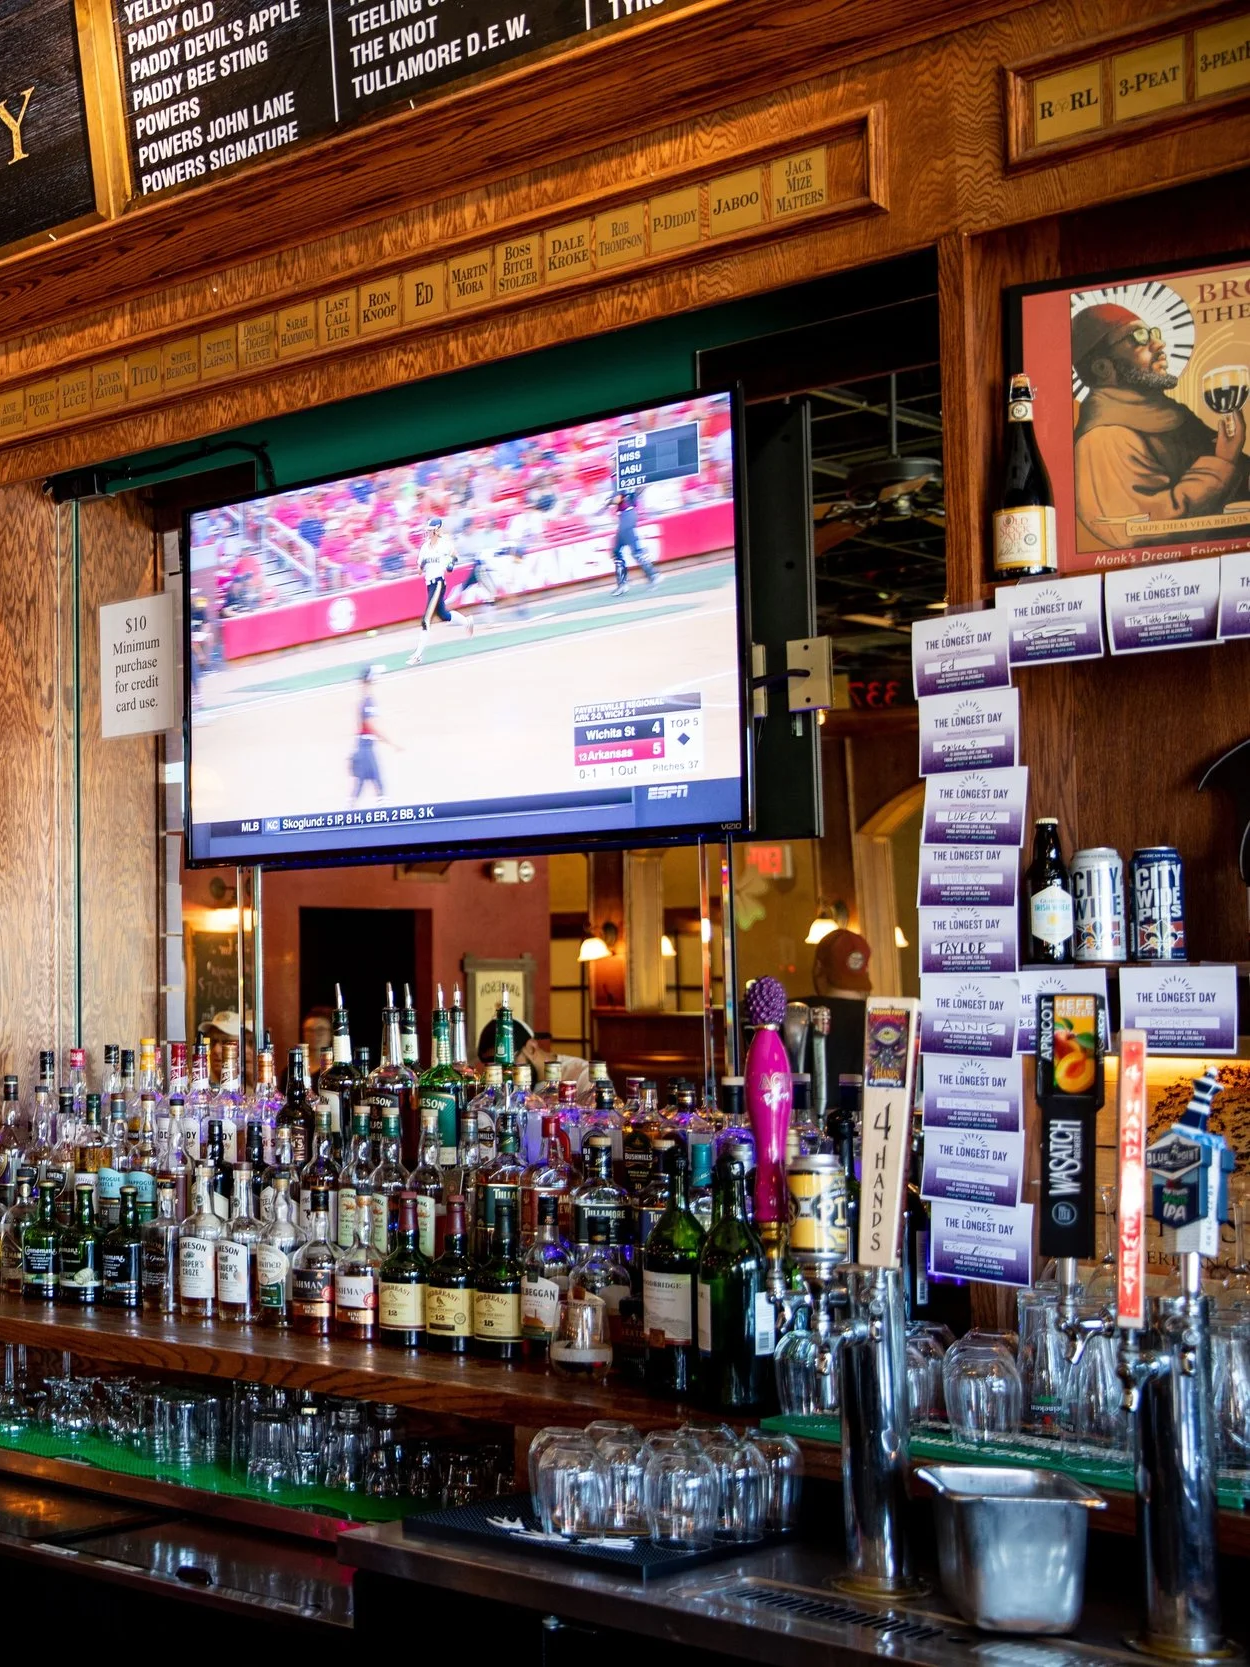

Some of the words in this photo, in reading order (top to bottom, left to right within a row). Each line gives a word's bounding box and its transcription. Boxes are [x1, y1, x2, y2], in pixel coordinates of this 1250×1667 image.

[128, 15, 178, 54] PADDY
[182, 1, 214, 31] OLD
[348, 0, 424, 37] TEELING
[130, 44, 180, 83] PADDY
[184, 19, 244, 62] DEVIL'S
[248, 0, 301, 37] APPLE
[350, 40, 383, 68] THE
[389, 16, 438, 55] KNOT
[352, 39, 461, 99] TULLAMORE
[467, 14, 531, 57] D.E.W.
[133, 73, 182, 111] PADDY
[187, 60, 216, 90] BEE
[220, 40, 268, 77] STING
[1119, 66, 1180, 97] 3-PEAT
[136, 96, 200, 140] POWERS
[138, 126, 203, 168] POWERS
[206, 108, 248, 143] JOHN
[253, 91, 295, 126] LANE
[141, 155, 206, 196] POWERS
[209, 121, 299, 170] SIGNATURE
[785, 157, 813, 178] JACK
[786, 175, 813, 194] MIZE
[713, 191, 759, 216] JABOO
[776, 188, 824, 214] MATTERS
[611, 221, 629, 237] ROB
[653, 209, 697, 233] P-DIDDY
[505, 243, 531, 261] BOSS
[552, 234, 585, 255] DALE
[599, 233, 643, 257] THOMPSON
[503, 257, 533, 277] BITCH
[548, 249, 589, 272] KROKE
[452, 263, 488, 284] MARTIN
[498, 272, 538, 292] STOLZER
[415, 282, 433, 307] ED
[456, 280, 484, 298] MORA
[325, 297, 350, 314] LAST
[368, 291, 391, 308] RON
[285, 316, 308, 332] SARAH
[325, 311, 350, 328] CALL
[363, 305, 397, 324] KNOOP
[281, 329, 314, 348] HAMMOND
[327, 324, 350, 342] LUIS
[206, 338, 231, 356] STEVE
[203, 351, 235, 370] LARSON
[132, 365, 158, 387] TITO
[620, 451, 641, 463] MISS
[1095, 552, 1136, 566] Monk's
[1125, 591, 1140, 603] THE
[1143, 587, 1181, 600] LONGEST
[1183, 584, 1200, 596] DAY
[125, 615, 147, 634] $10
[113, 638, 160, 656] Minimum
[115, 658, 158, 678] purchase
[115, 680, 129, 694] for
[131, 674, 159, 691] credit
[116, 697, 136, 713] card
[139, 697, 158, 710] use.
[585, 726, 622, 741] Wichita
[623, 725, 635, 737] St
[651, 721, 660, 734] 4
[671, 719, 690, 728] TOP
[693, 717, 699, 726] 5
[587, 747, 634, 761] Arkansas
[652, 742, 661, 755] 5
[617, 765, 637, 776] Out
[652, 762, 685, 773] Pitches
[688, 760, 699, 769] 37
[647, 784, 688, 800] ESPN
[939, 789, 954, 799] THE
[956, 789, 991, 799] LONGEST
[993, 789, 1009, 799] DAY
[241, 821, 259, 833] MLB
[266, 820, 278, 831] KC
[282, 816, 325, 832] Skoglund:
[327, 815, 333, 825] 5
[346, 813, 352, 824] 8
[366, 811, 372, 822] 6
[374, 810, 390, 823] ER,
[391, 809, 398, 819] 2
[400, 808, 417, 821] BB,
[418, 807, 424, 817] 3
[426, 806, 434, 816] K
[1136, 864, 1181, 891] CITY
[1137, 887, 1181, 909] WIDE
[932, 920, 946, 930] THE
[949, 920, 983, 930] LONGEST
[985, 919, 1000, 929] DAY
[935, 940, 986, 955] TAYLOR
[1055, 998, 1094, 1009] HEFE
[941, 1019, 999, 1035] ANNIE
[1041, 998, 1054, 1061] APRICOT
[873, 1102, 892, 1141] 4
[1049, 1119, 1082, 1196] WASATCH
[1146, 1152, 1169, 1164] BLUE
[870, 1145, 886, 1251] HANDS
[583, 1207, 625, 1219] TULLAMORE
[1162, 1203, 1186, 1221] IPA
